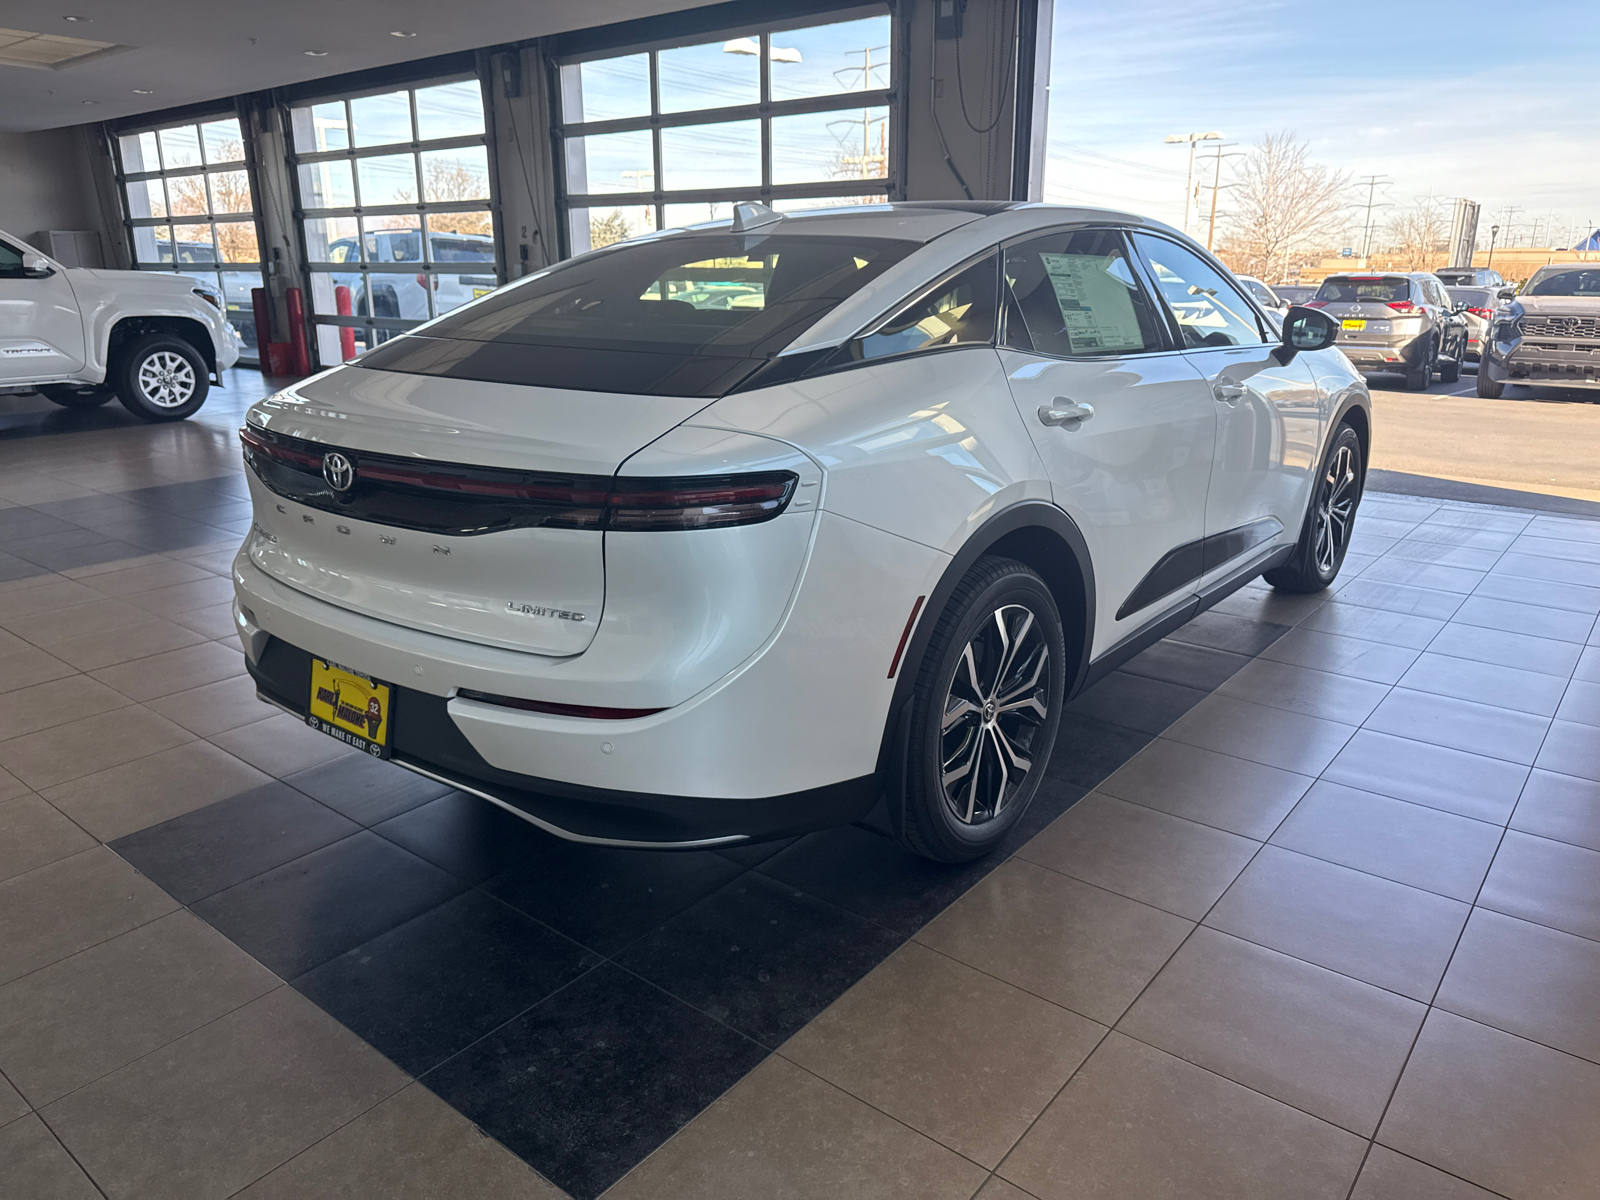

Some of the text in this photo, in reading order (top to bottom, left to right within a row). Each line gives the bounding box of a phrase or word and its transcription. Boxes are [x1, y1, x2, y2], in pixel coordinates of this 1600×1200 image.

[521, 225, 528, 239] 2
[276, 504, 451, 556] CROWN
[507, 601, 586, 621] LIMITED
[316, 686, 336, 707] KARL
[337, 704, 366, 729] MALONE
[370, 702, 378, 714] 32
[322, 723, 366, 750] WE MAKE IT EASY
